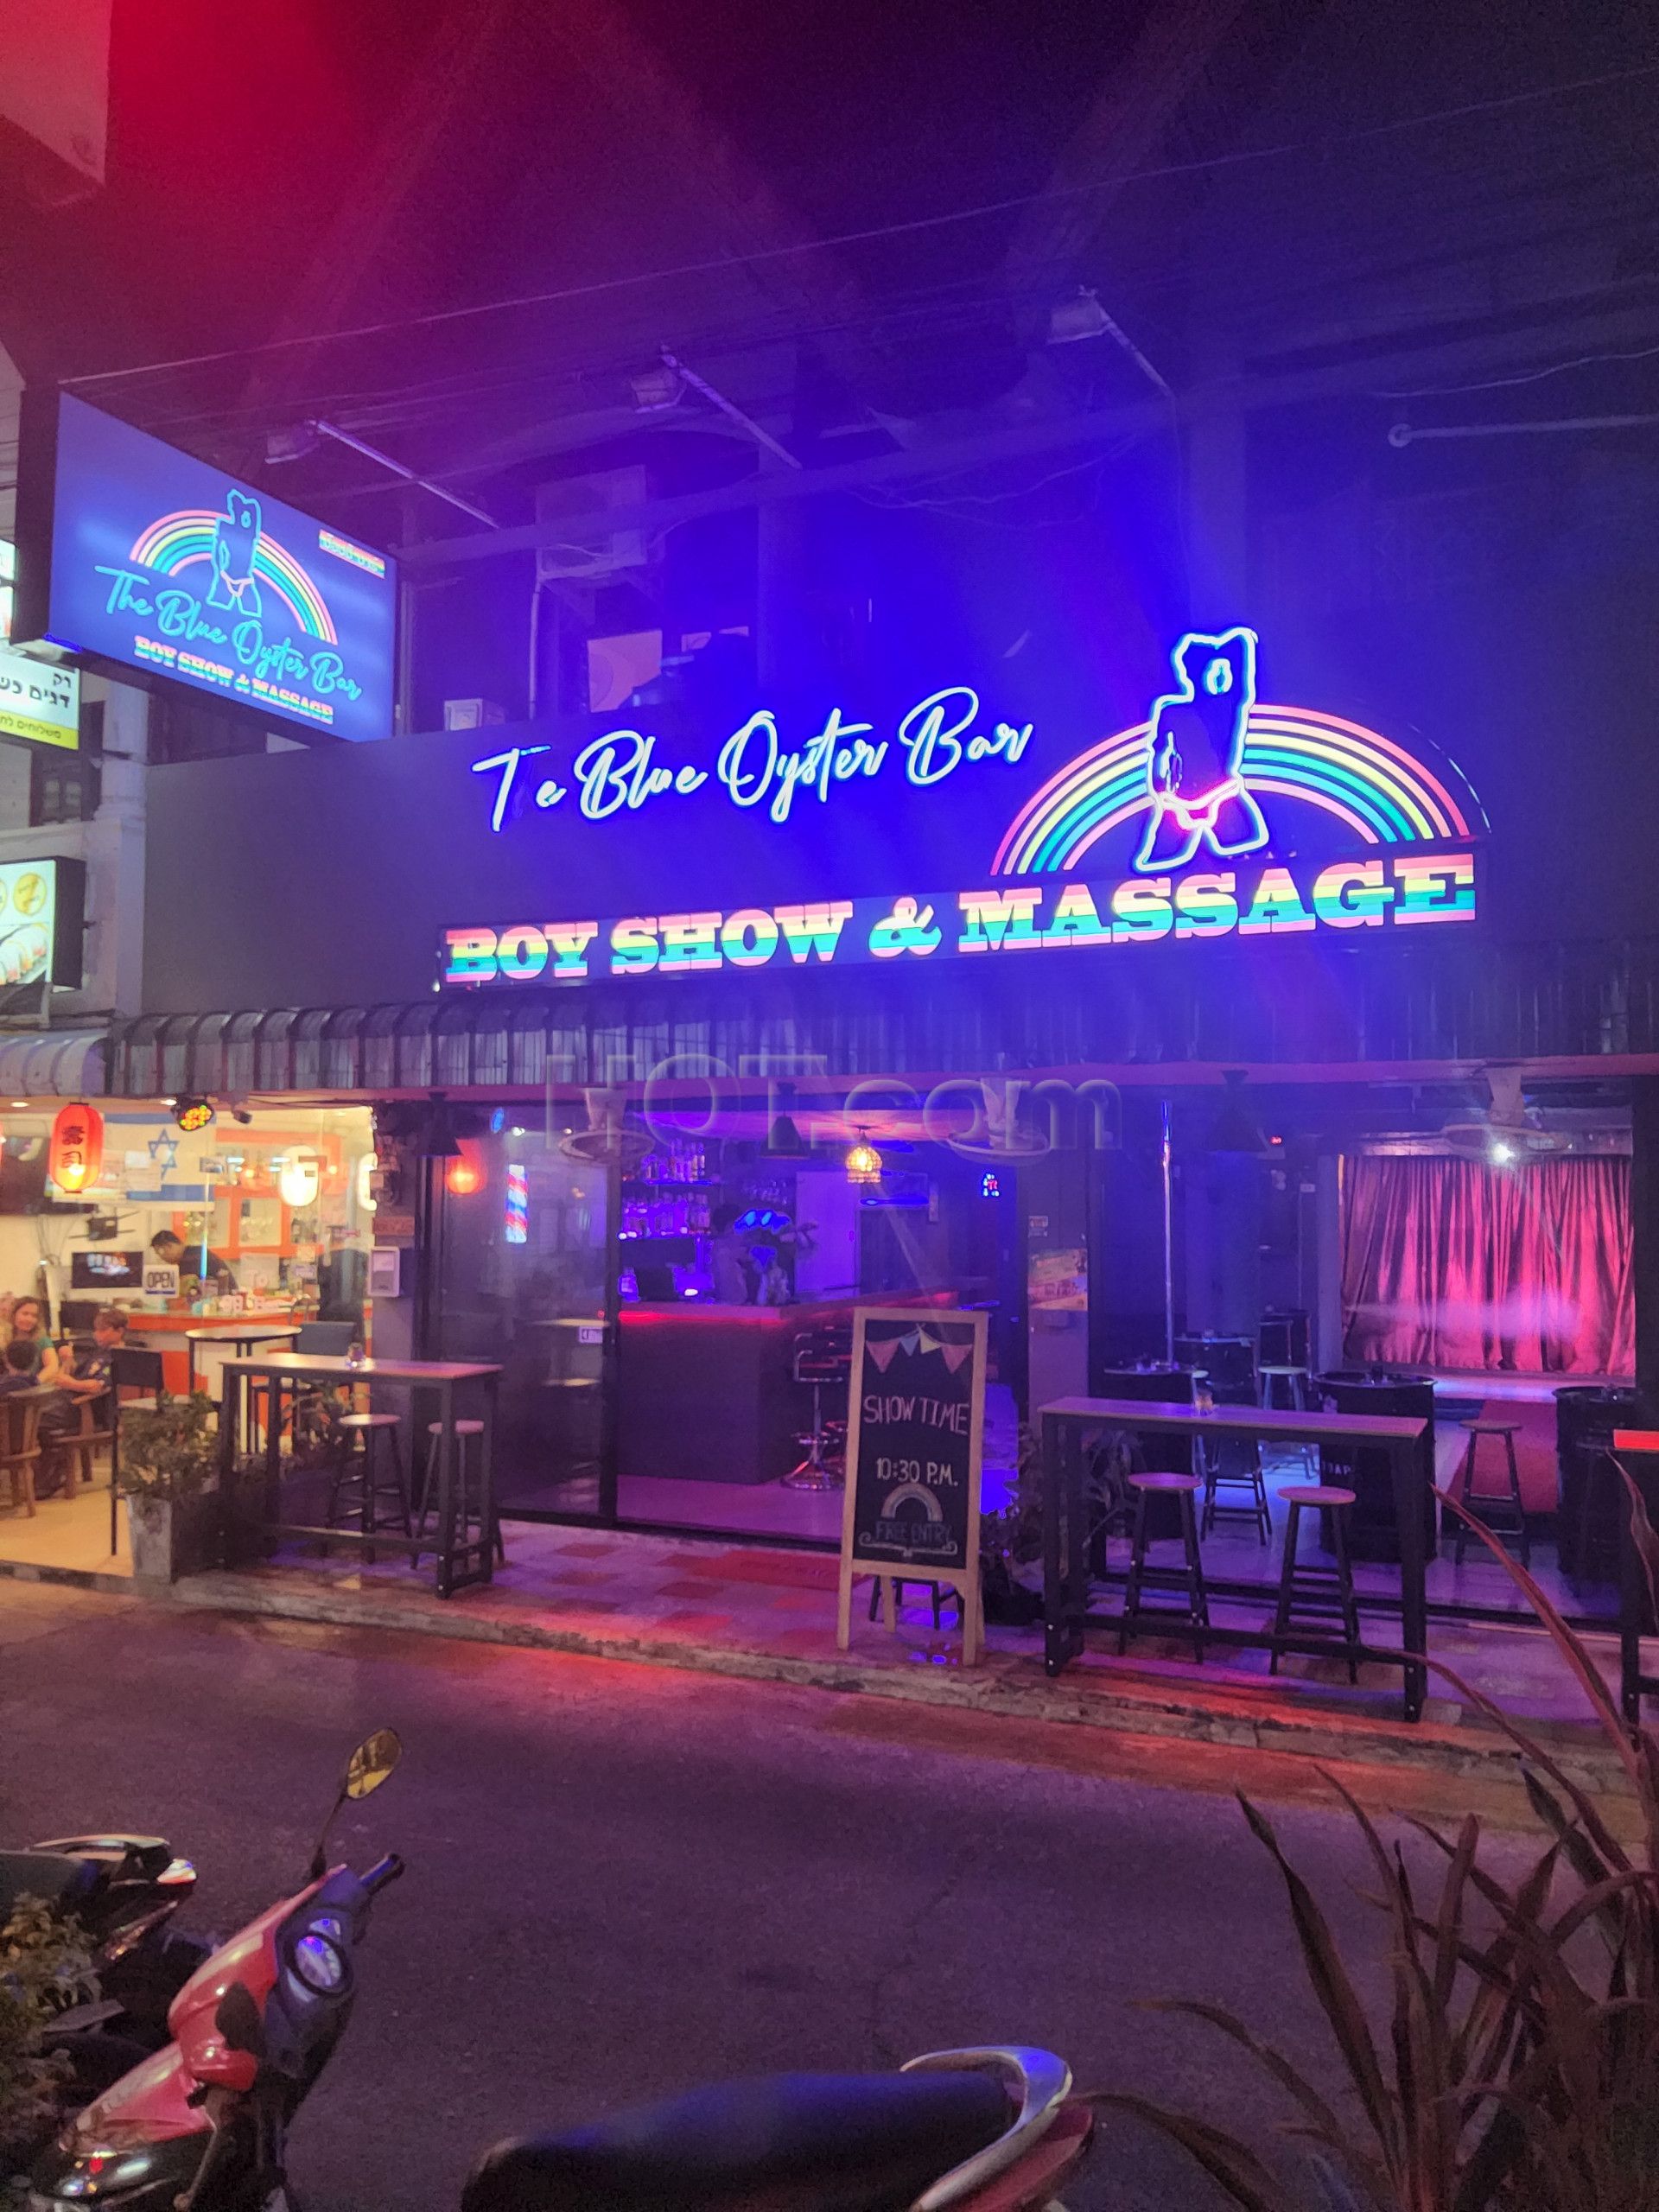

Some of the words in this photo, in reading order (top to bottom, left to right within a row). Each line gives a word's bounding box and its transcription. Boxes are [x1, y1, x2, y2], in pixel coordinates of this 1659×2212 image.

[93, 565, 155, 616] The
[155, 589, 228, 645] Blue
[232, 620, 309, 681] Oyster
[309, 652, 363, 701] Bar
[53, 672, 72, 689] רק
[134, 635, 177, 668] BOY
[177, 652, 234, 688] SHOW
[234, 673, 251, 694] &
[251, 677, 334, 725] MASSAGE
[29, 683, 70, 709] דגים
[573, 729, 709, 820] Blue
[718, 708, 888, 823] Oyster
[898, 686, 1034, 785] Bar
[445, 922, 599, 982] BOY
[610, 901, 854, 975] SHOW
[868, 896, 943, 957] &
[958, 853, 1476, 952] MASSAGE
[146, 1270, 175, 1288] OPEN
[875, 1457, 921, 1484] 10:30
[926, 1461, 959, 1487] P.M.
[875, 1521, 908, 1541] FREE
